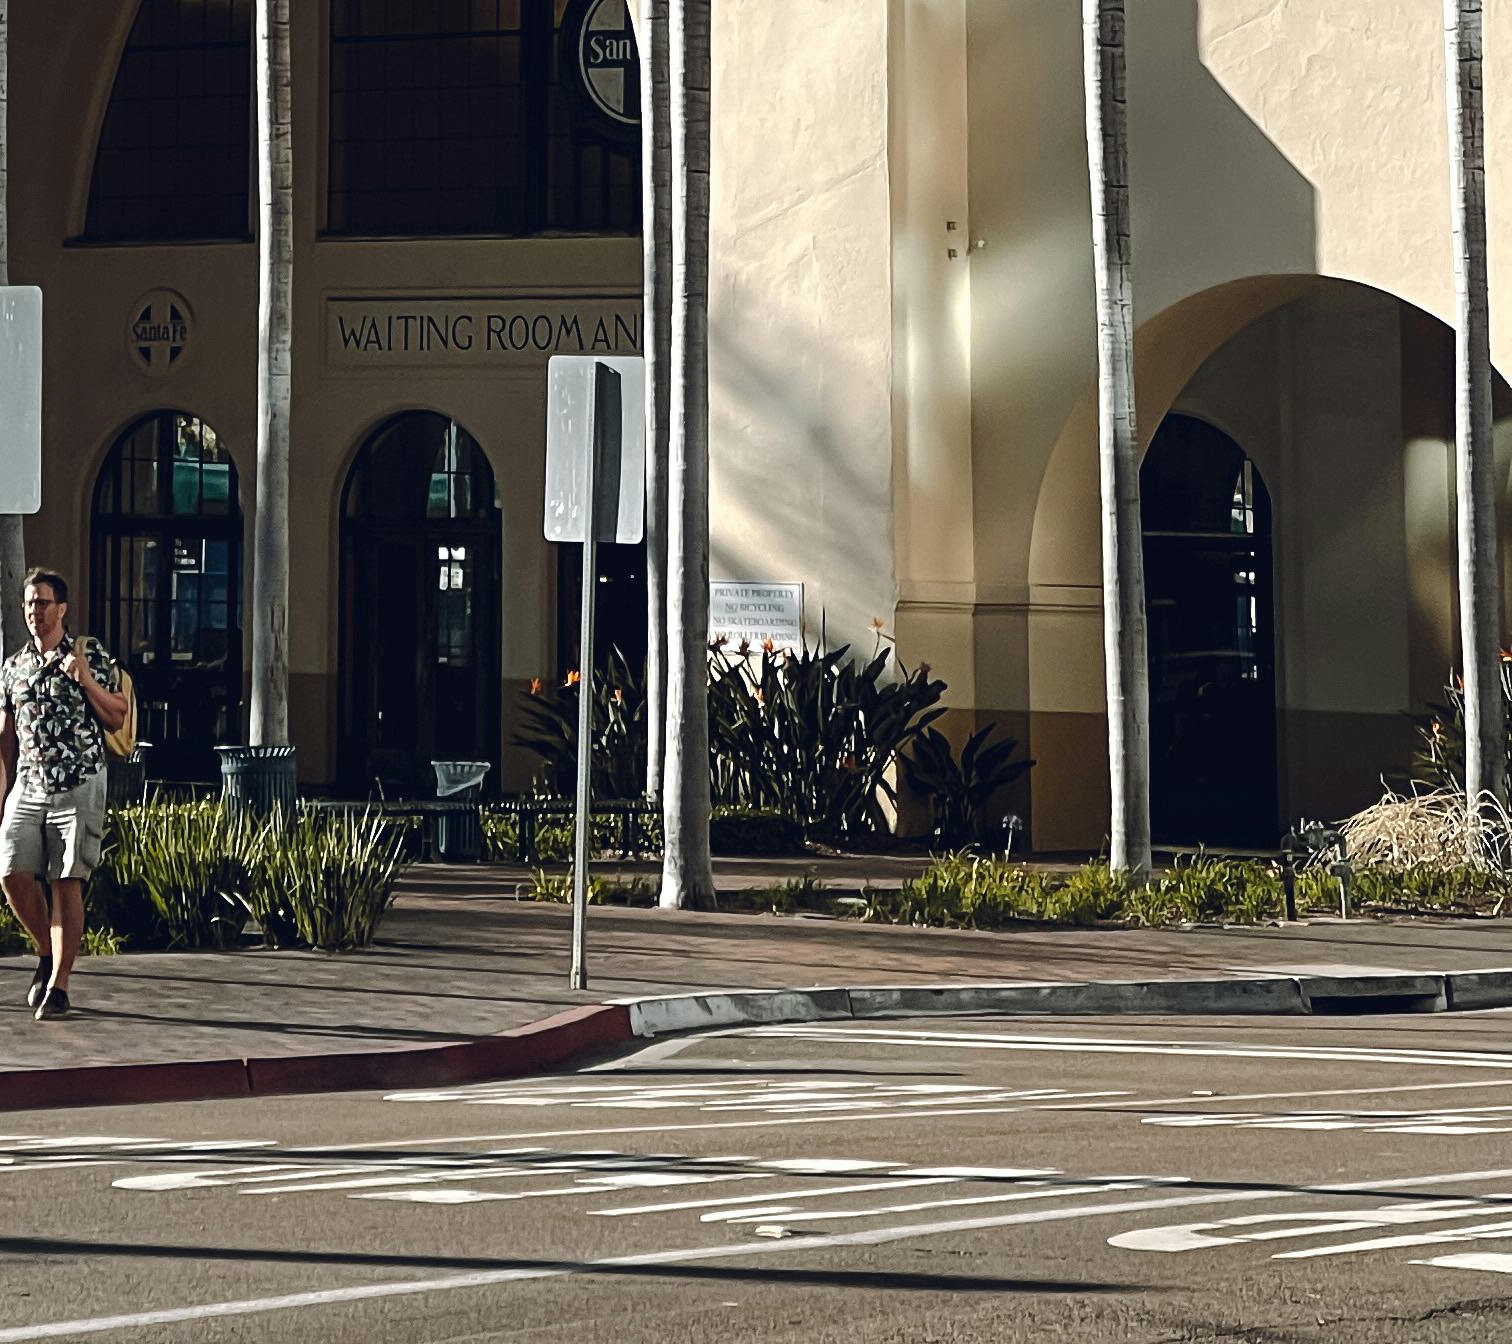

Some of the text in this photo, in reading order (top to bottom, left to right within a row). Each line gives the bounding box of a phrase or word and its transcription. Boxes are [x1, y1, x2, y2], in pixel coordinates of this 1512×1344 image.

[590, 35, 632, 63] San
[131, 322, 187, 343] Santa Fe
[338, 313, 644, 352] WAITING ROOM AN
[714, 588, 795, 599] PRIVATE PROPERTY
[725, 602, 785, 613] NO BICYCLING
[713, 616, 797, 627] NO SKATEBOARDING
